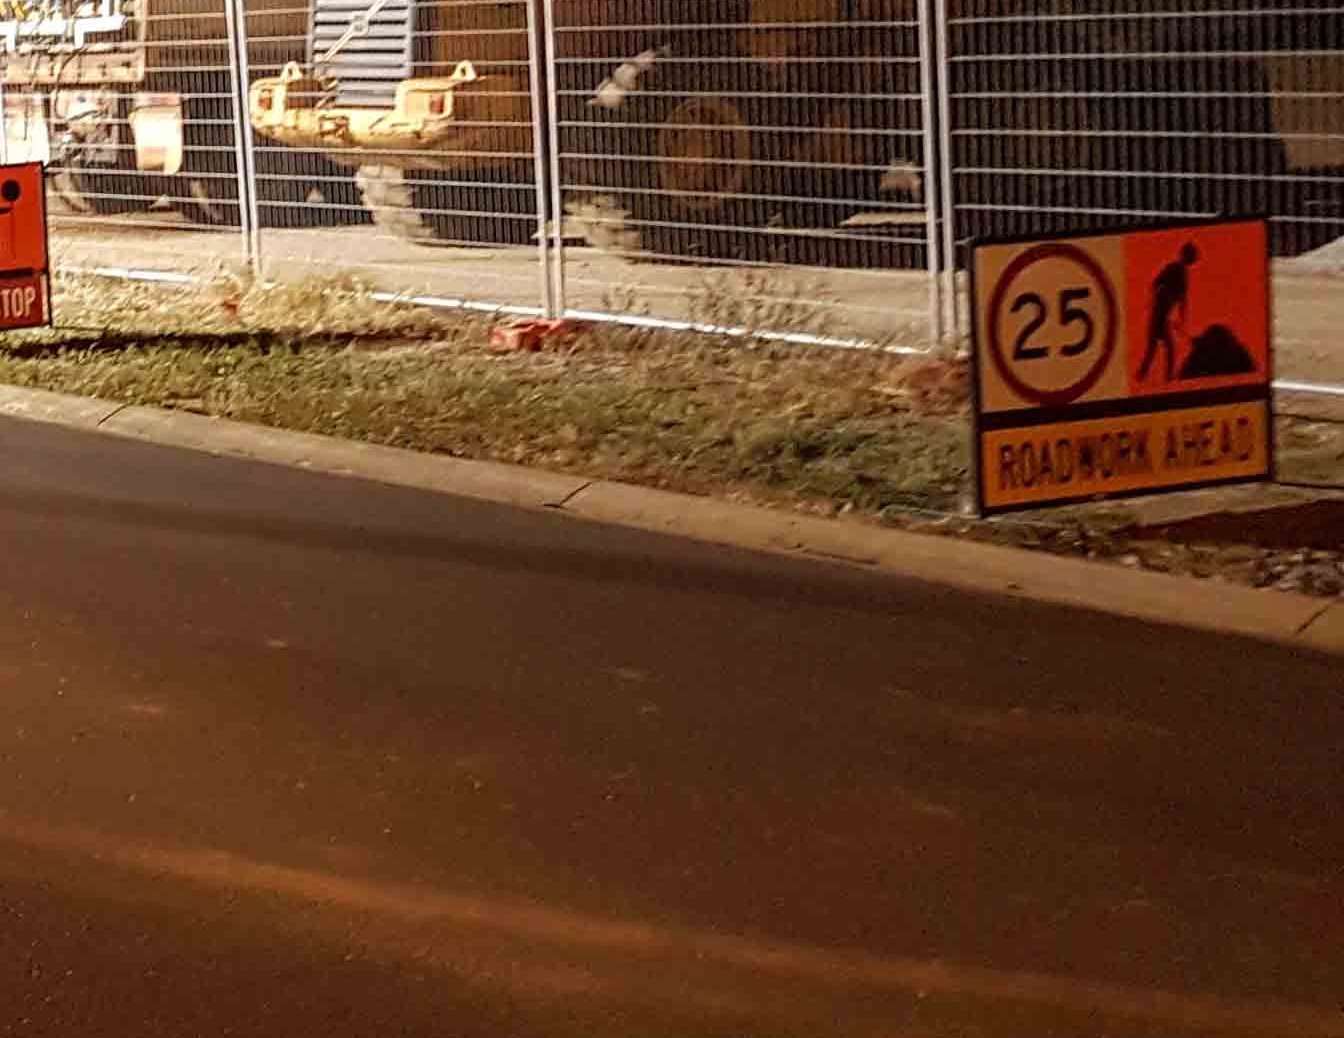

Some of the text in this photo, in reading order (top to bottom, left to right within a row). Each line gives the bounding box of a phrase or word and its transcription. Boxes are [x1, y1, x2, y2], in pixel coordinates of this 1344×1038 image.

[1009, 287, 1095, 361] 25
[998, 415, 1256, 492] ROADWORK AHEAD
